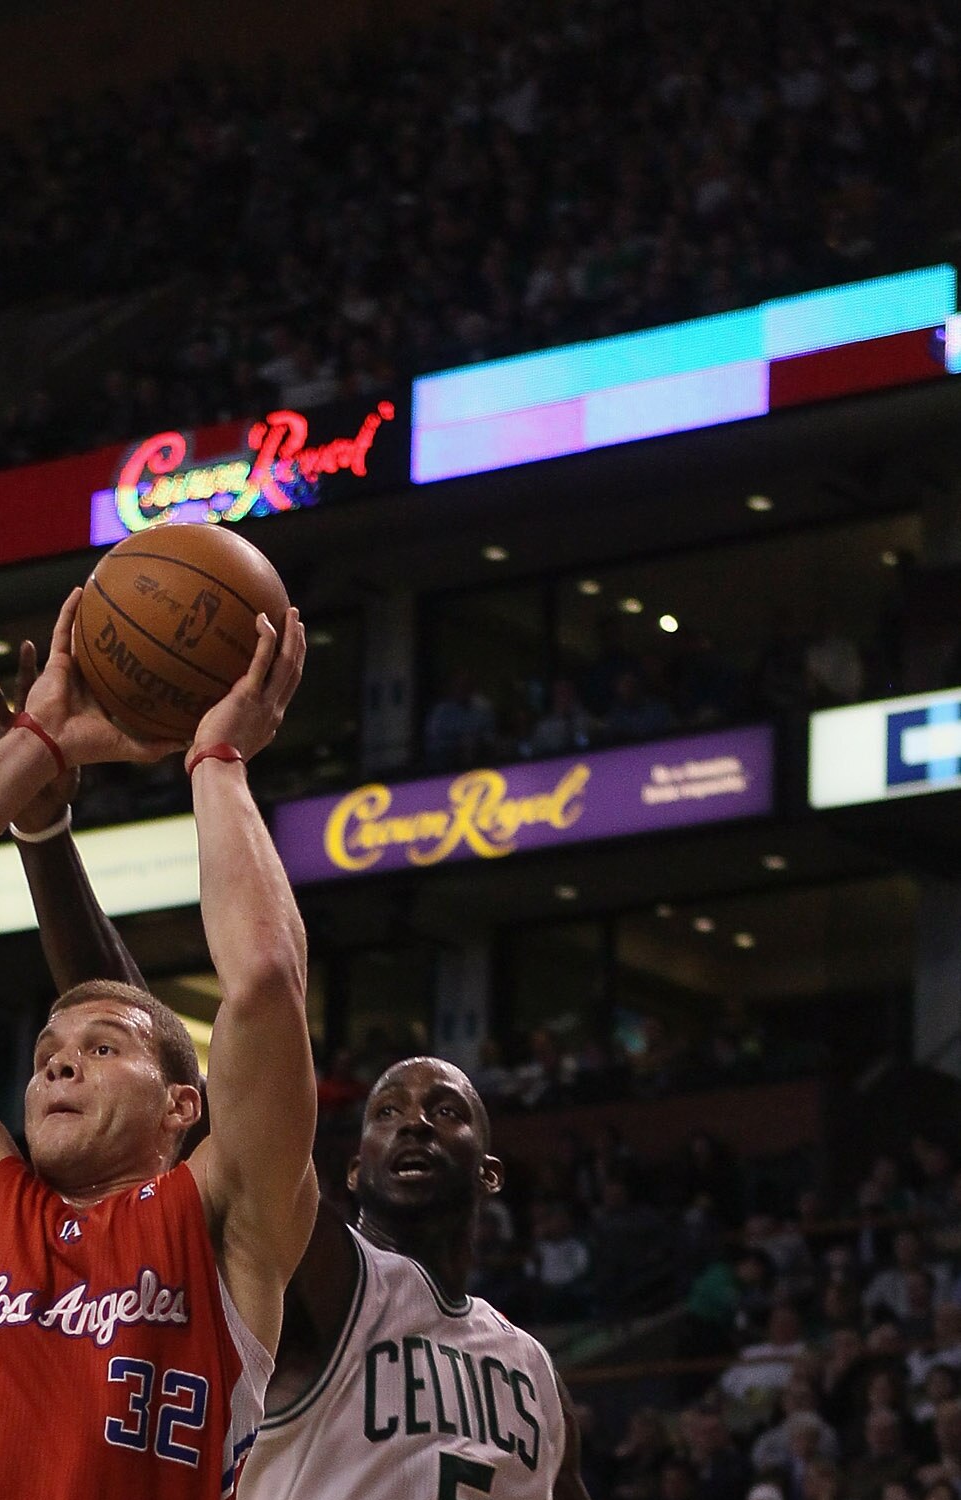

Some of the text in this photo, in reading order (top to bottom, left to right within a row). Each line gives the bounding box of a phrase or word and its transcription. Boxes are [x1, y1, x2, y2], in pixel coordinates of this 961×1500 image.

[323, 763, 592, 872] Crown Royal
[38, 1269, 188, 1346] Angeles
[104, 1356, 209, 1469] 32
[364, 1335, 540, 1472] CELTICS
